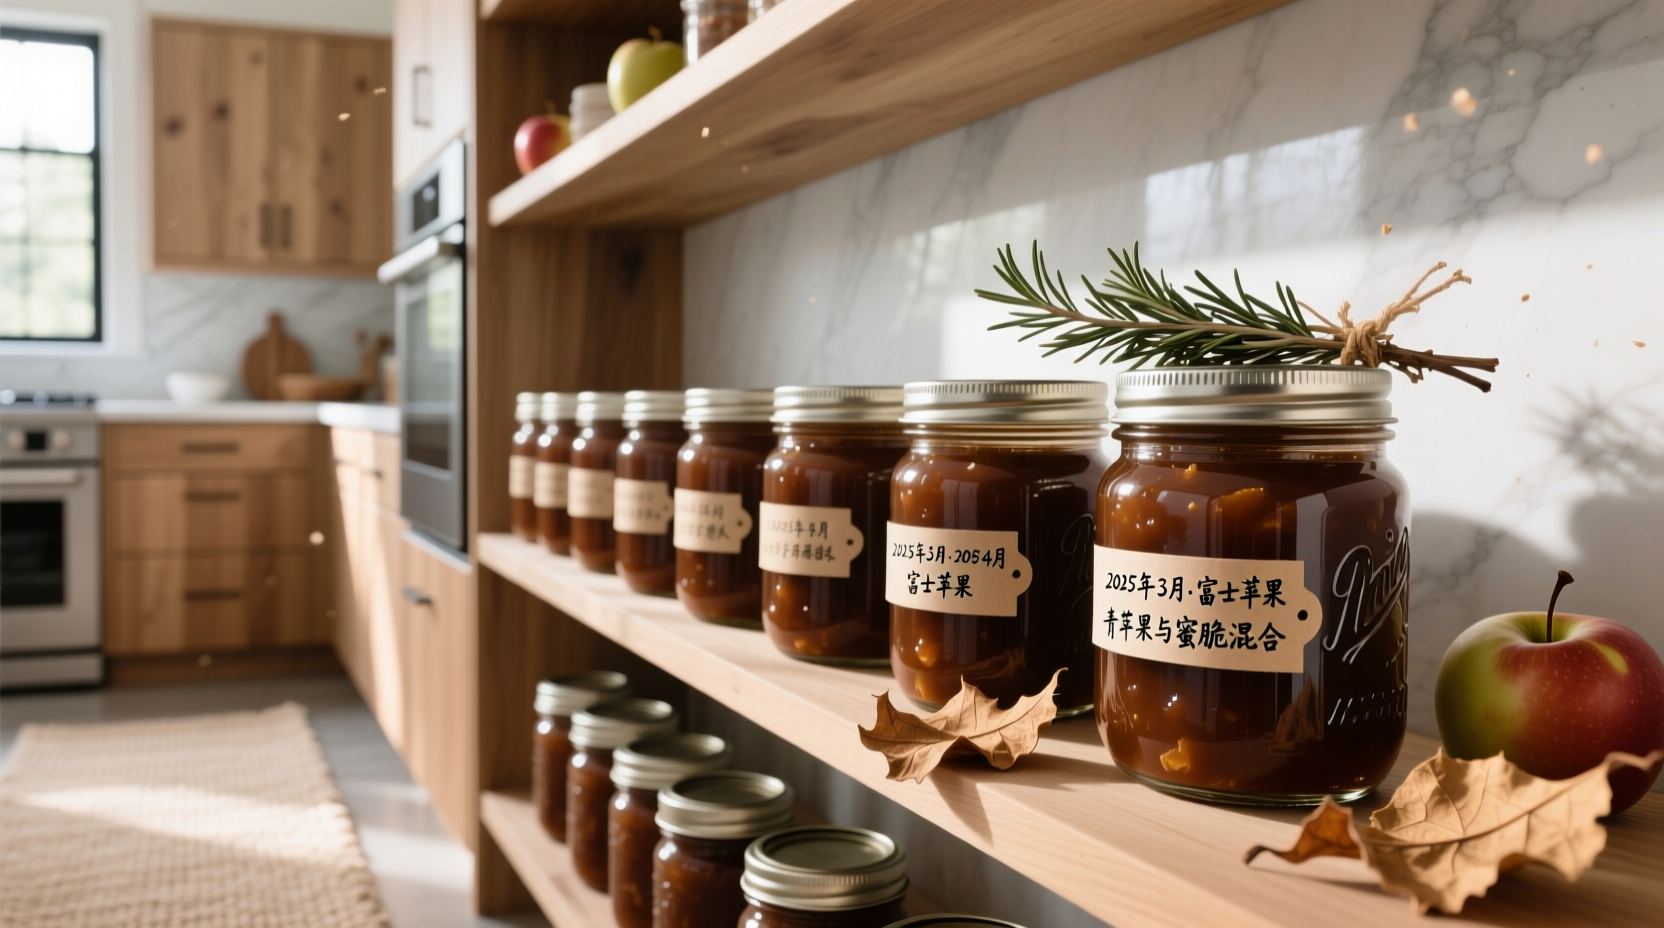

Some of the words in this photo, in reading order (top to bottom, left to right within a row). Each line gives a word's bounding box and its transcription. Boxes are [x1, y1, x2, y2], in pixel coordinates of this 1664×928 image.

[907, 570, 973, 599] 富士苹果
[1105, 572, 1286, 609] 2025年3月·富士苹果
[1103, 607, 1286, 652] 青苹果与蜜脆混合
